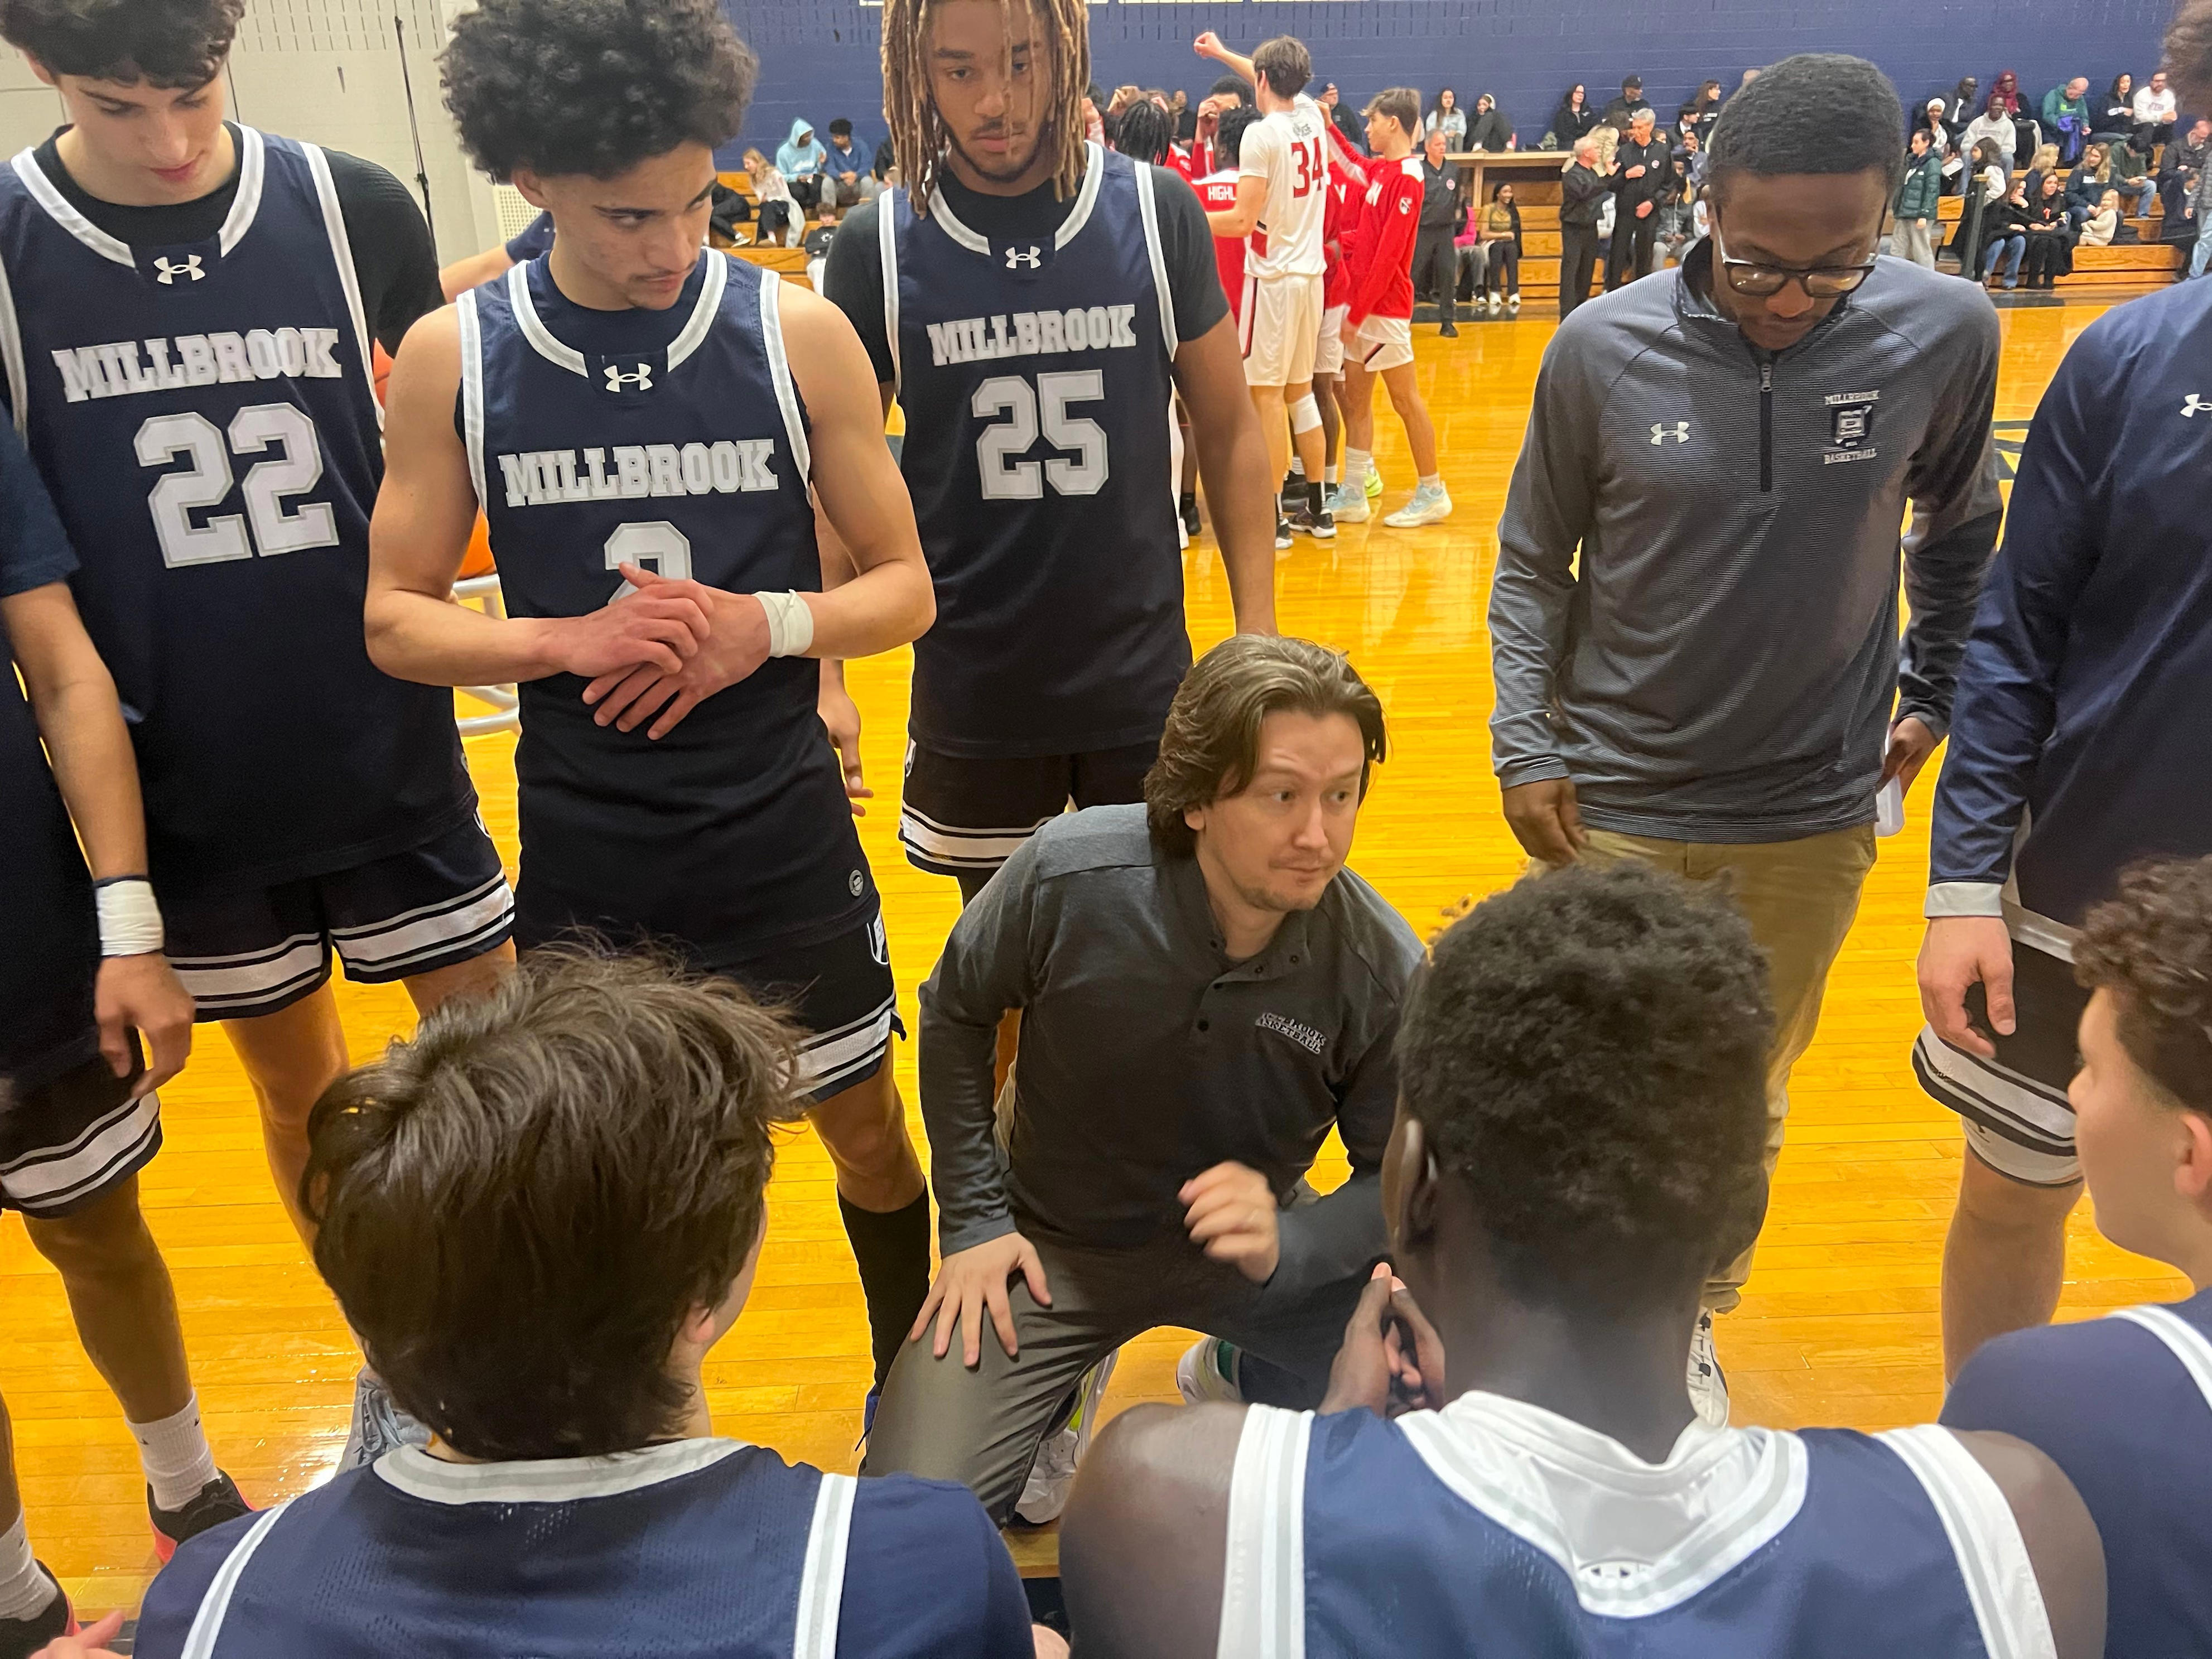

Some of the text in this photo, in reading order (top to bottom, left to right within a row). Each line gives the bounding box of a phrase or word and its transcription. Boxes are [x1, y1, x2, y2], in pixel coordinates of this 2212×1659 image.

[1291, 136, 1324, 198] 34
[51, 327, 343, 403] MILLBROOK
[926, 304, 1137, 366] MILLBROOK
[971, 369, 1109, 499] 25
[133, 402, 340, 568] 22
[498, 438, 779, 507] MILLBROOK
